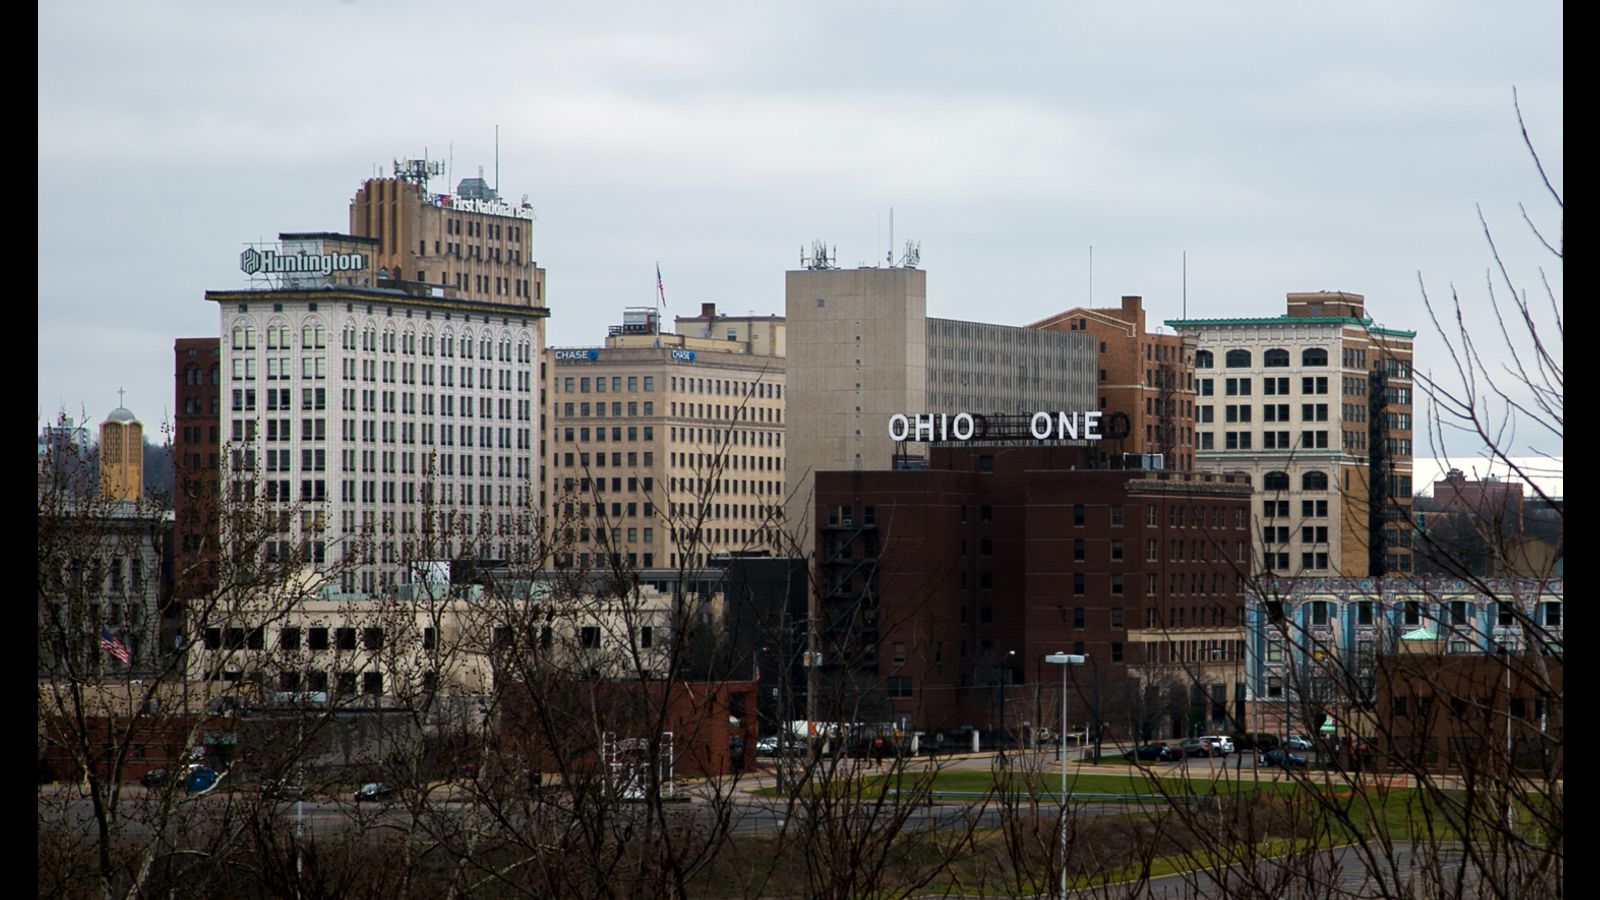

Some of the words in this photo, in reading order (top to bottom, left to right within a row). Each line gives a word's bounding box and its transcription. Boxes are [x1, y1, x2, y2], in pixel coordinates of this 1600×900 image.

[260, 250, 362, 276] Huntington
[555, 350, 588, 360] CHASE
[672, 349, 691, 361] CHASE
[888, 412, 974, 442] OHIO
[1030, 411, 1102, 440] ONE
